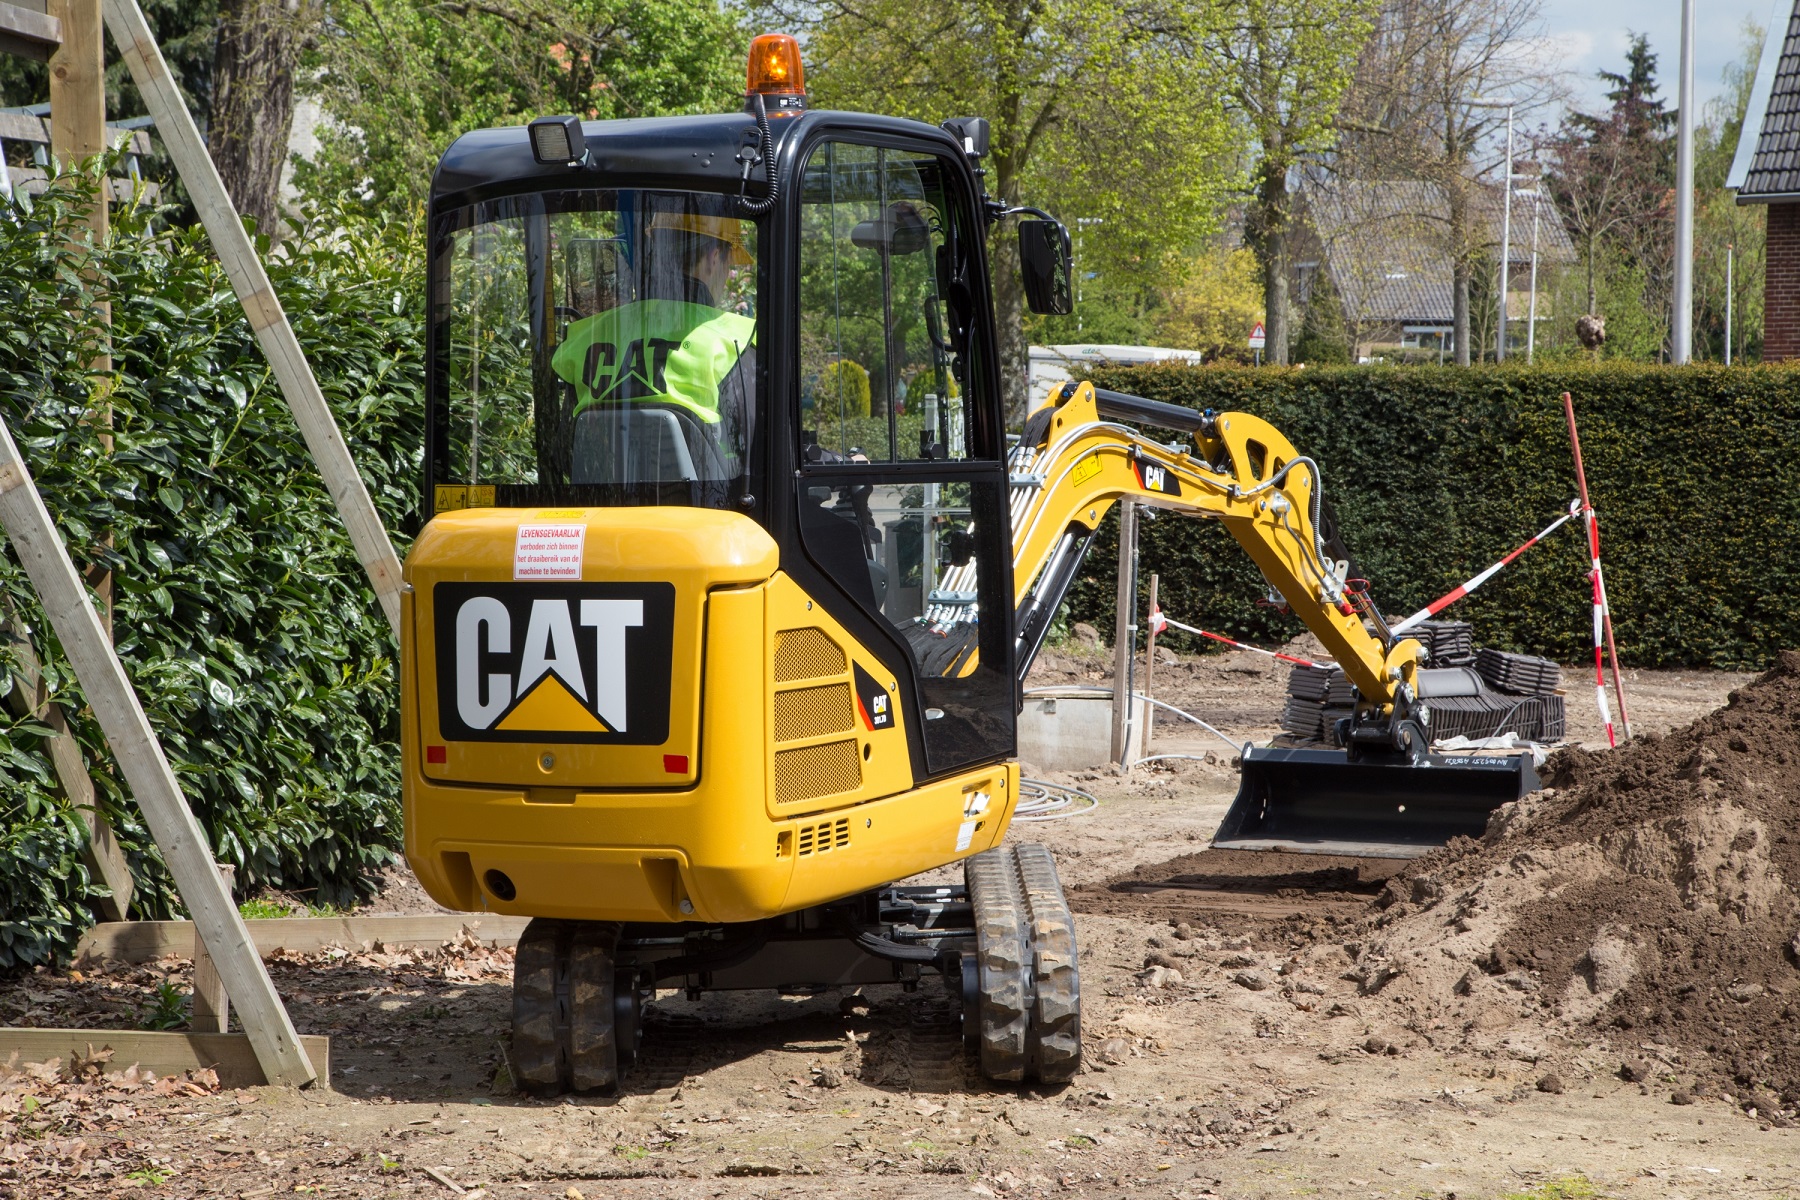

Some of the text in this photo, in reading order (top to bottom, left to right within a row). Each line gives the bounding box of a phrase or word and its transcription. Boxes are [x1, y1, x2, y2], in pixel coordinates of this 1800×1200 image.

[1145, 465, 1165, 491] CAT
[521, 529, 580, 538] LEVENSGEVAARLIJK
[519, 567, 541, 575] machine
[550, 567, 576, 575] bevinden
[456, 597, 643, 732] CAT
[873, 695, 887, 713] CAT
